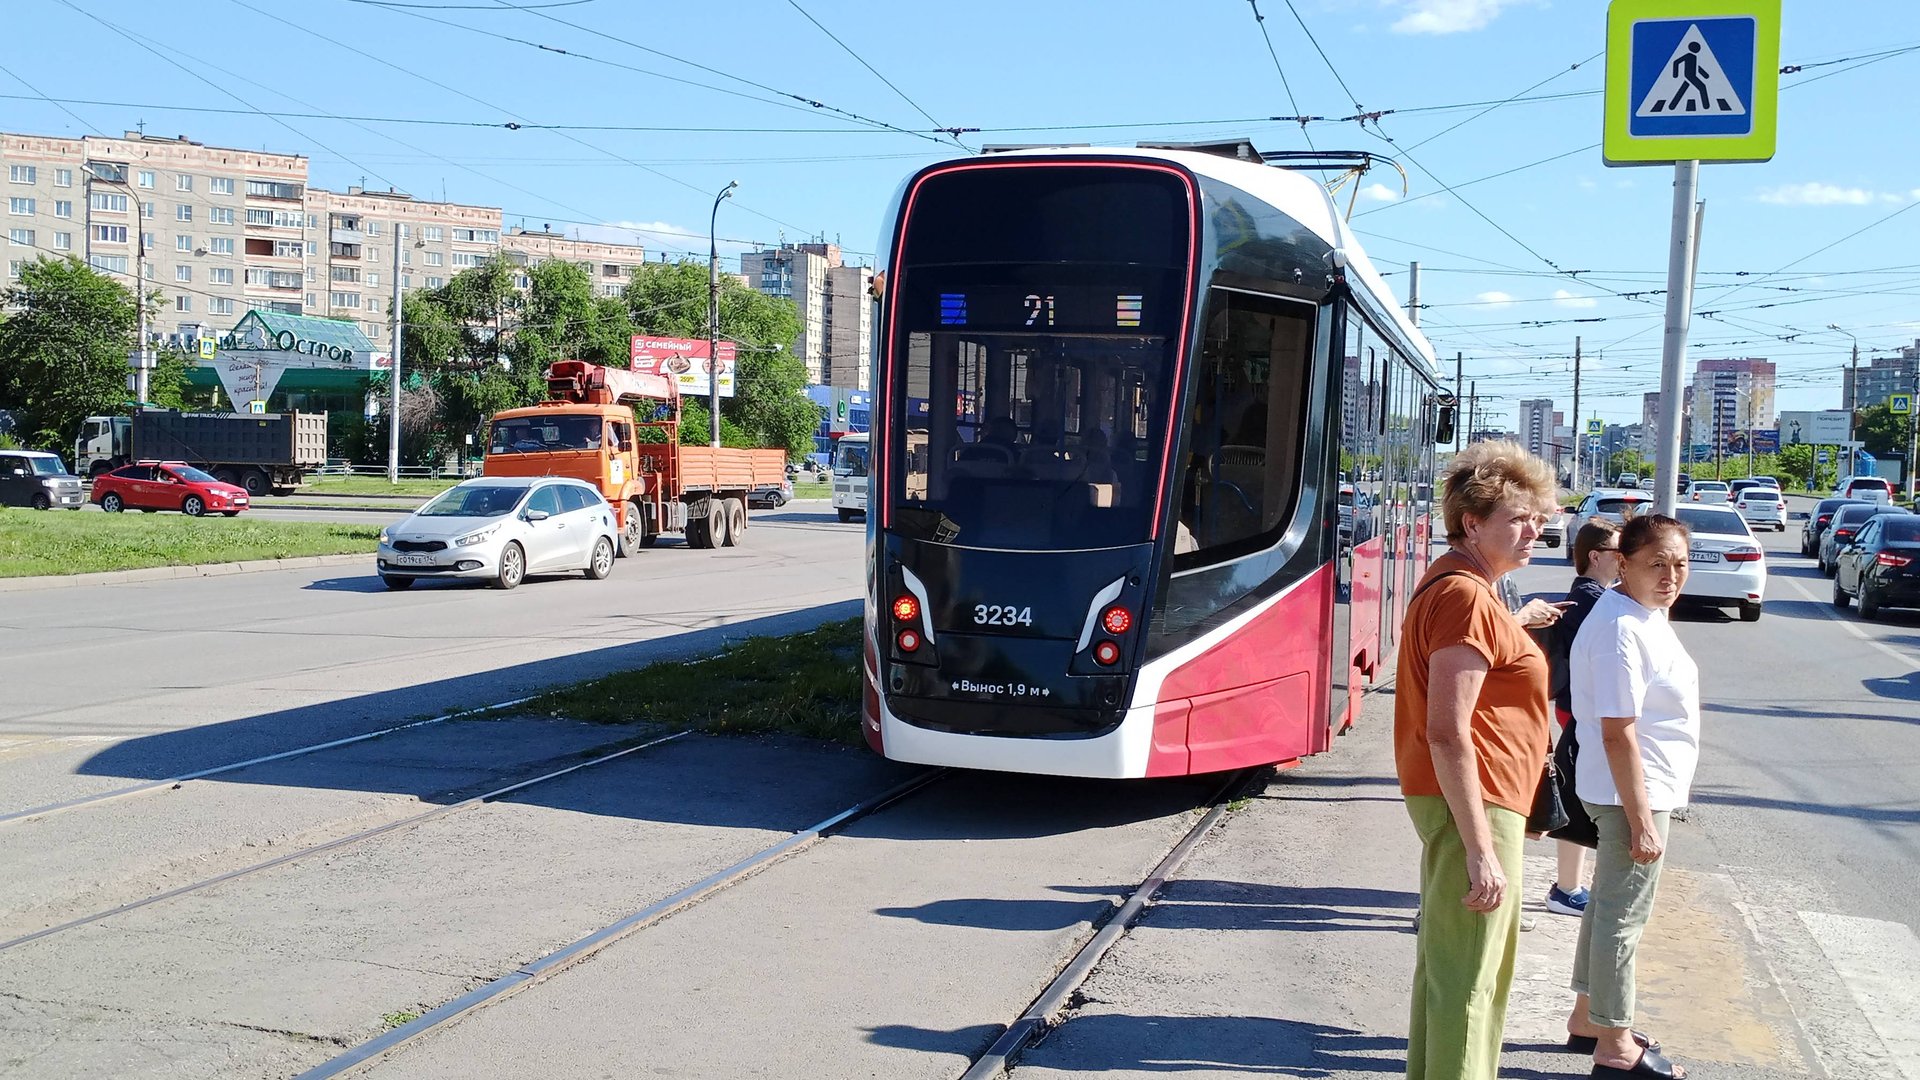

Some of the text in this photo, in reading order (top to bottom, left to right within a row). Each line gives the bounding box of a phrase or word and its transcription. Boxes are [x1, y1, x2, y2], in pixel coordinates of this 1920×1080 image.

[646, 340, 692, 351] СЕМЕЙНЫЙ
[974, 604, 1032, 626] 3234
[961, 680, 1039, 697] Вынос 1,9 м
